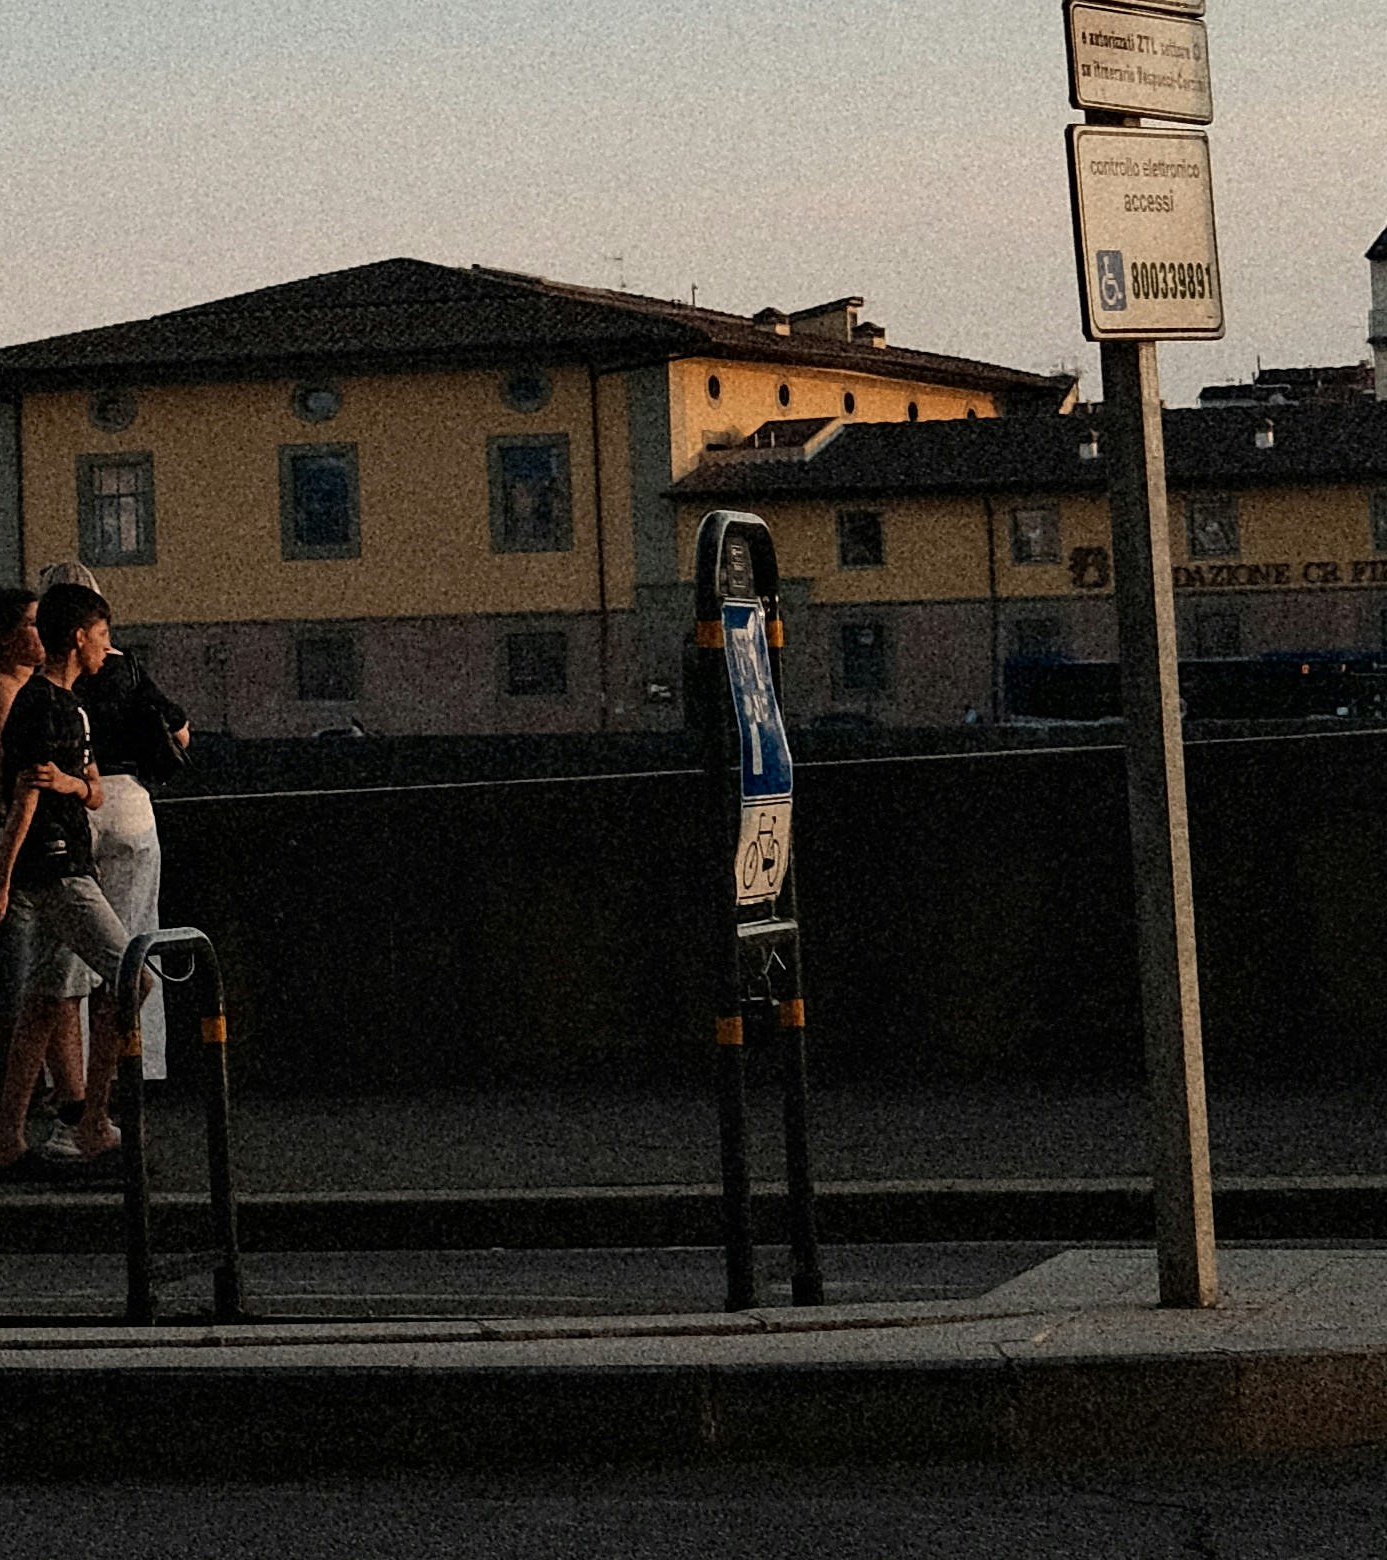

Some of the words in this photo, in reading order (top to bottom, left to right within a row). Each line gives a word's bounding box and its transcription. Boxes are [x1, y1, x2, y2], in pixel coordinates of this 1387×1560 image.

[1136, 34, 1158, 55] ZTL
[1090, 156, 1140, 177] controllo
[1142, 158, 1200, 179] elettronico
[1124, 190, 1175, 213] accessi
[1131, 262, 1214, 300] 800339891
[1173, 563, 1290, 587] DAZIONE
